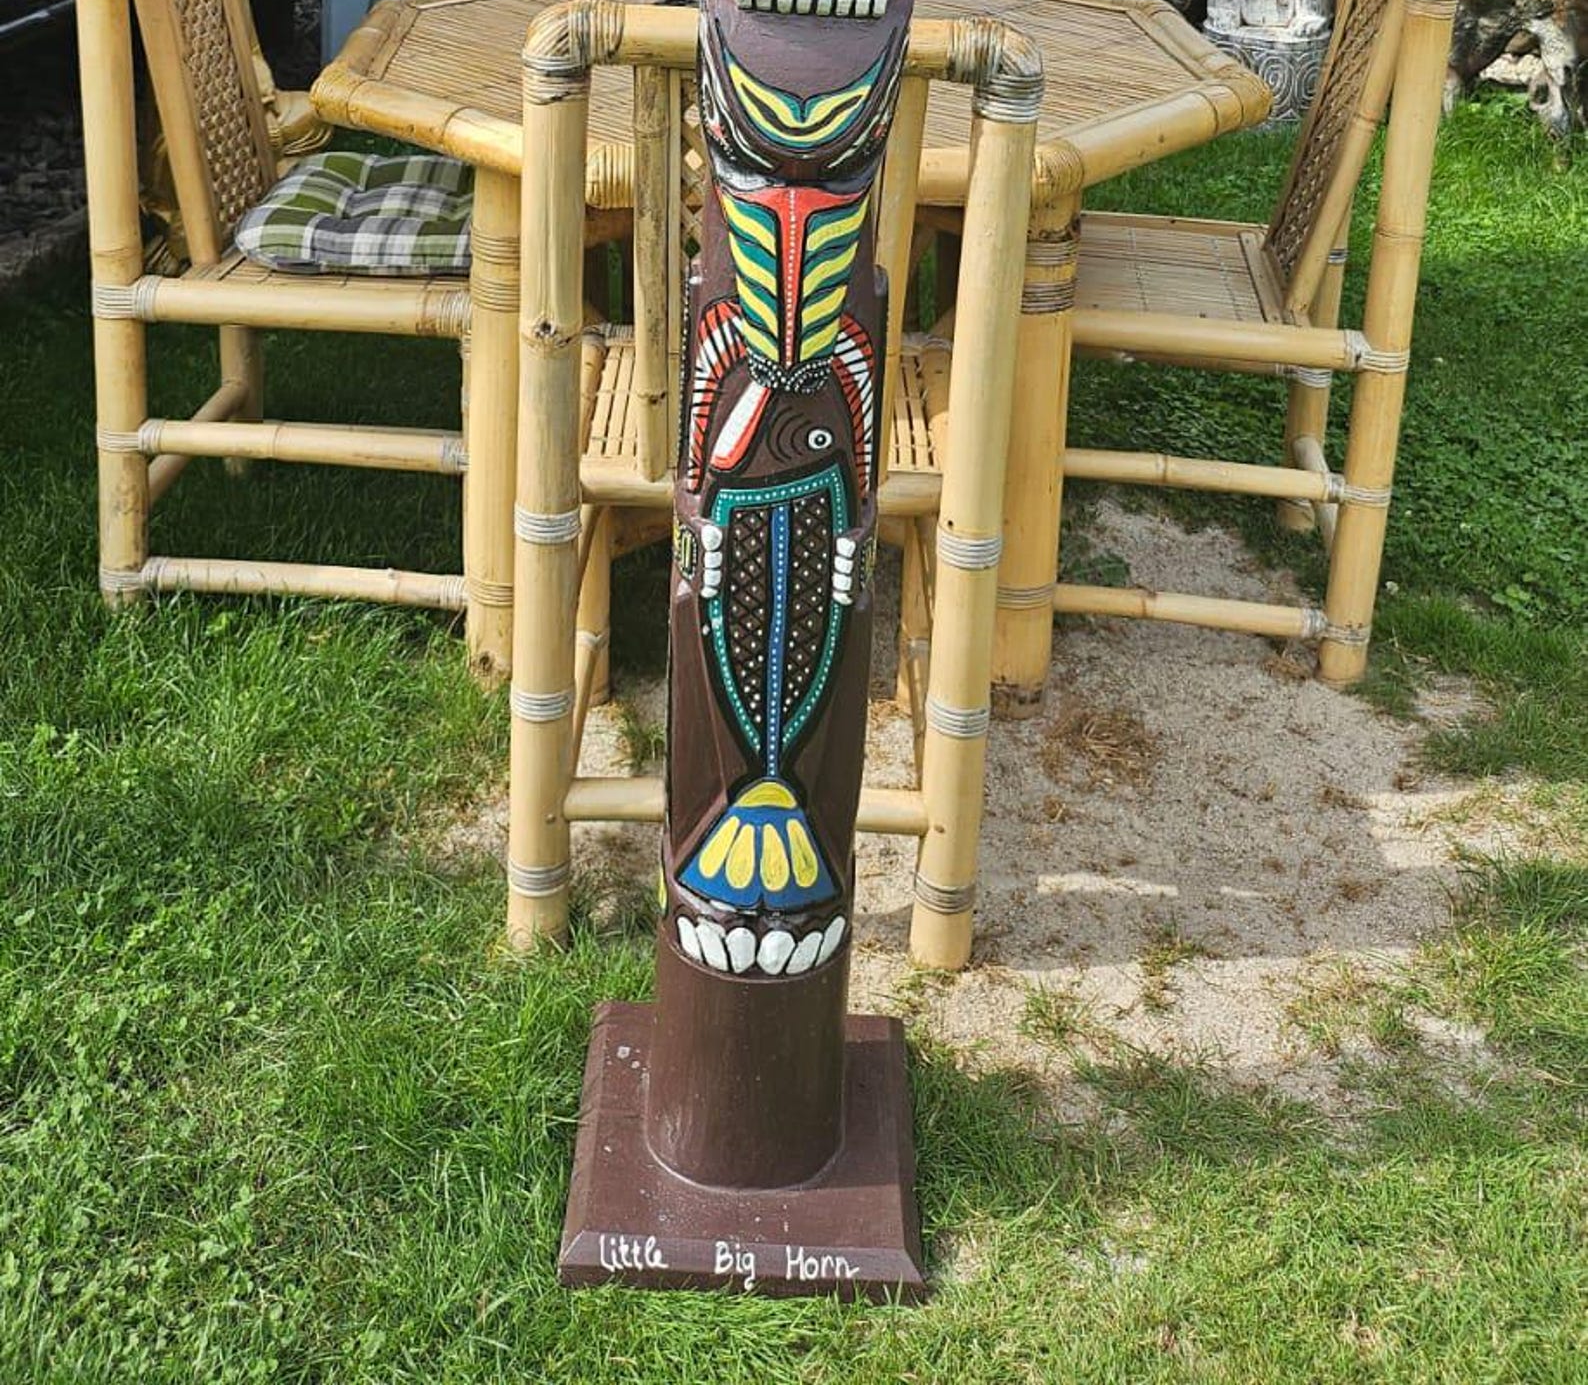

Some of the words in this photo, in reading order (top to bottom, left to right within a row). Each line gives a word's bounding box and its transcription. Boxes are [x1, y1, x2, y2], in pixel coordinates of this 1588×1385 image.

[600, 1234, 669, 1272] Little
[715, 1241, 756, 1290] Big
[786, 1245, 860, 1280] Horn
